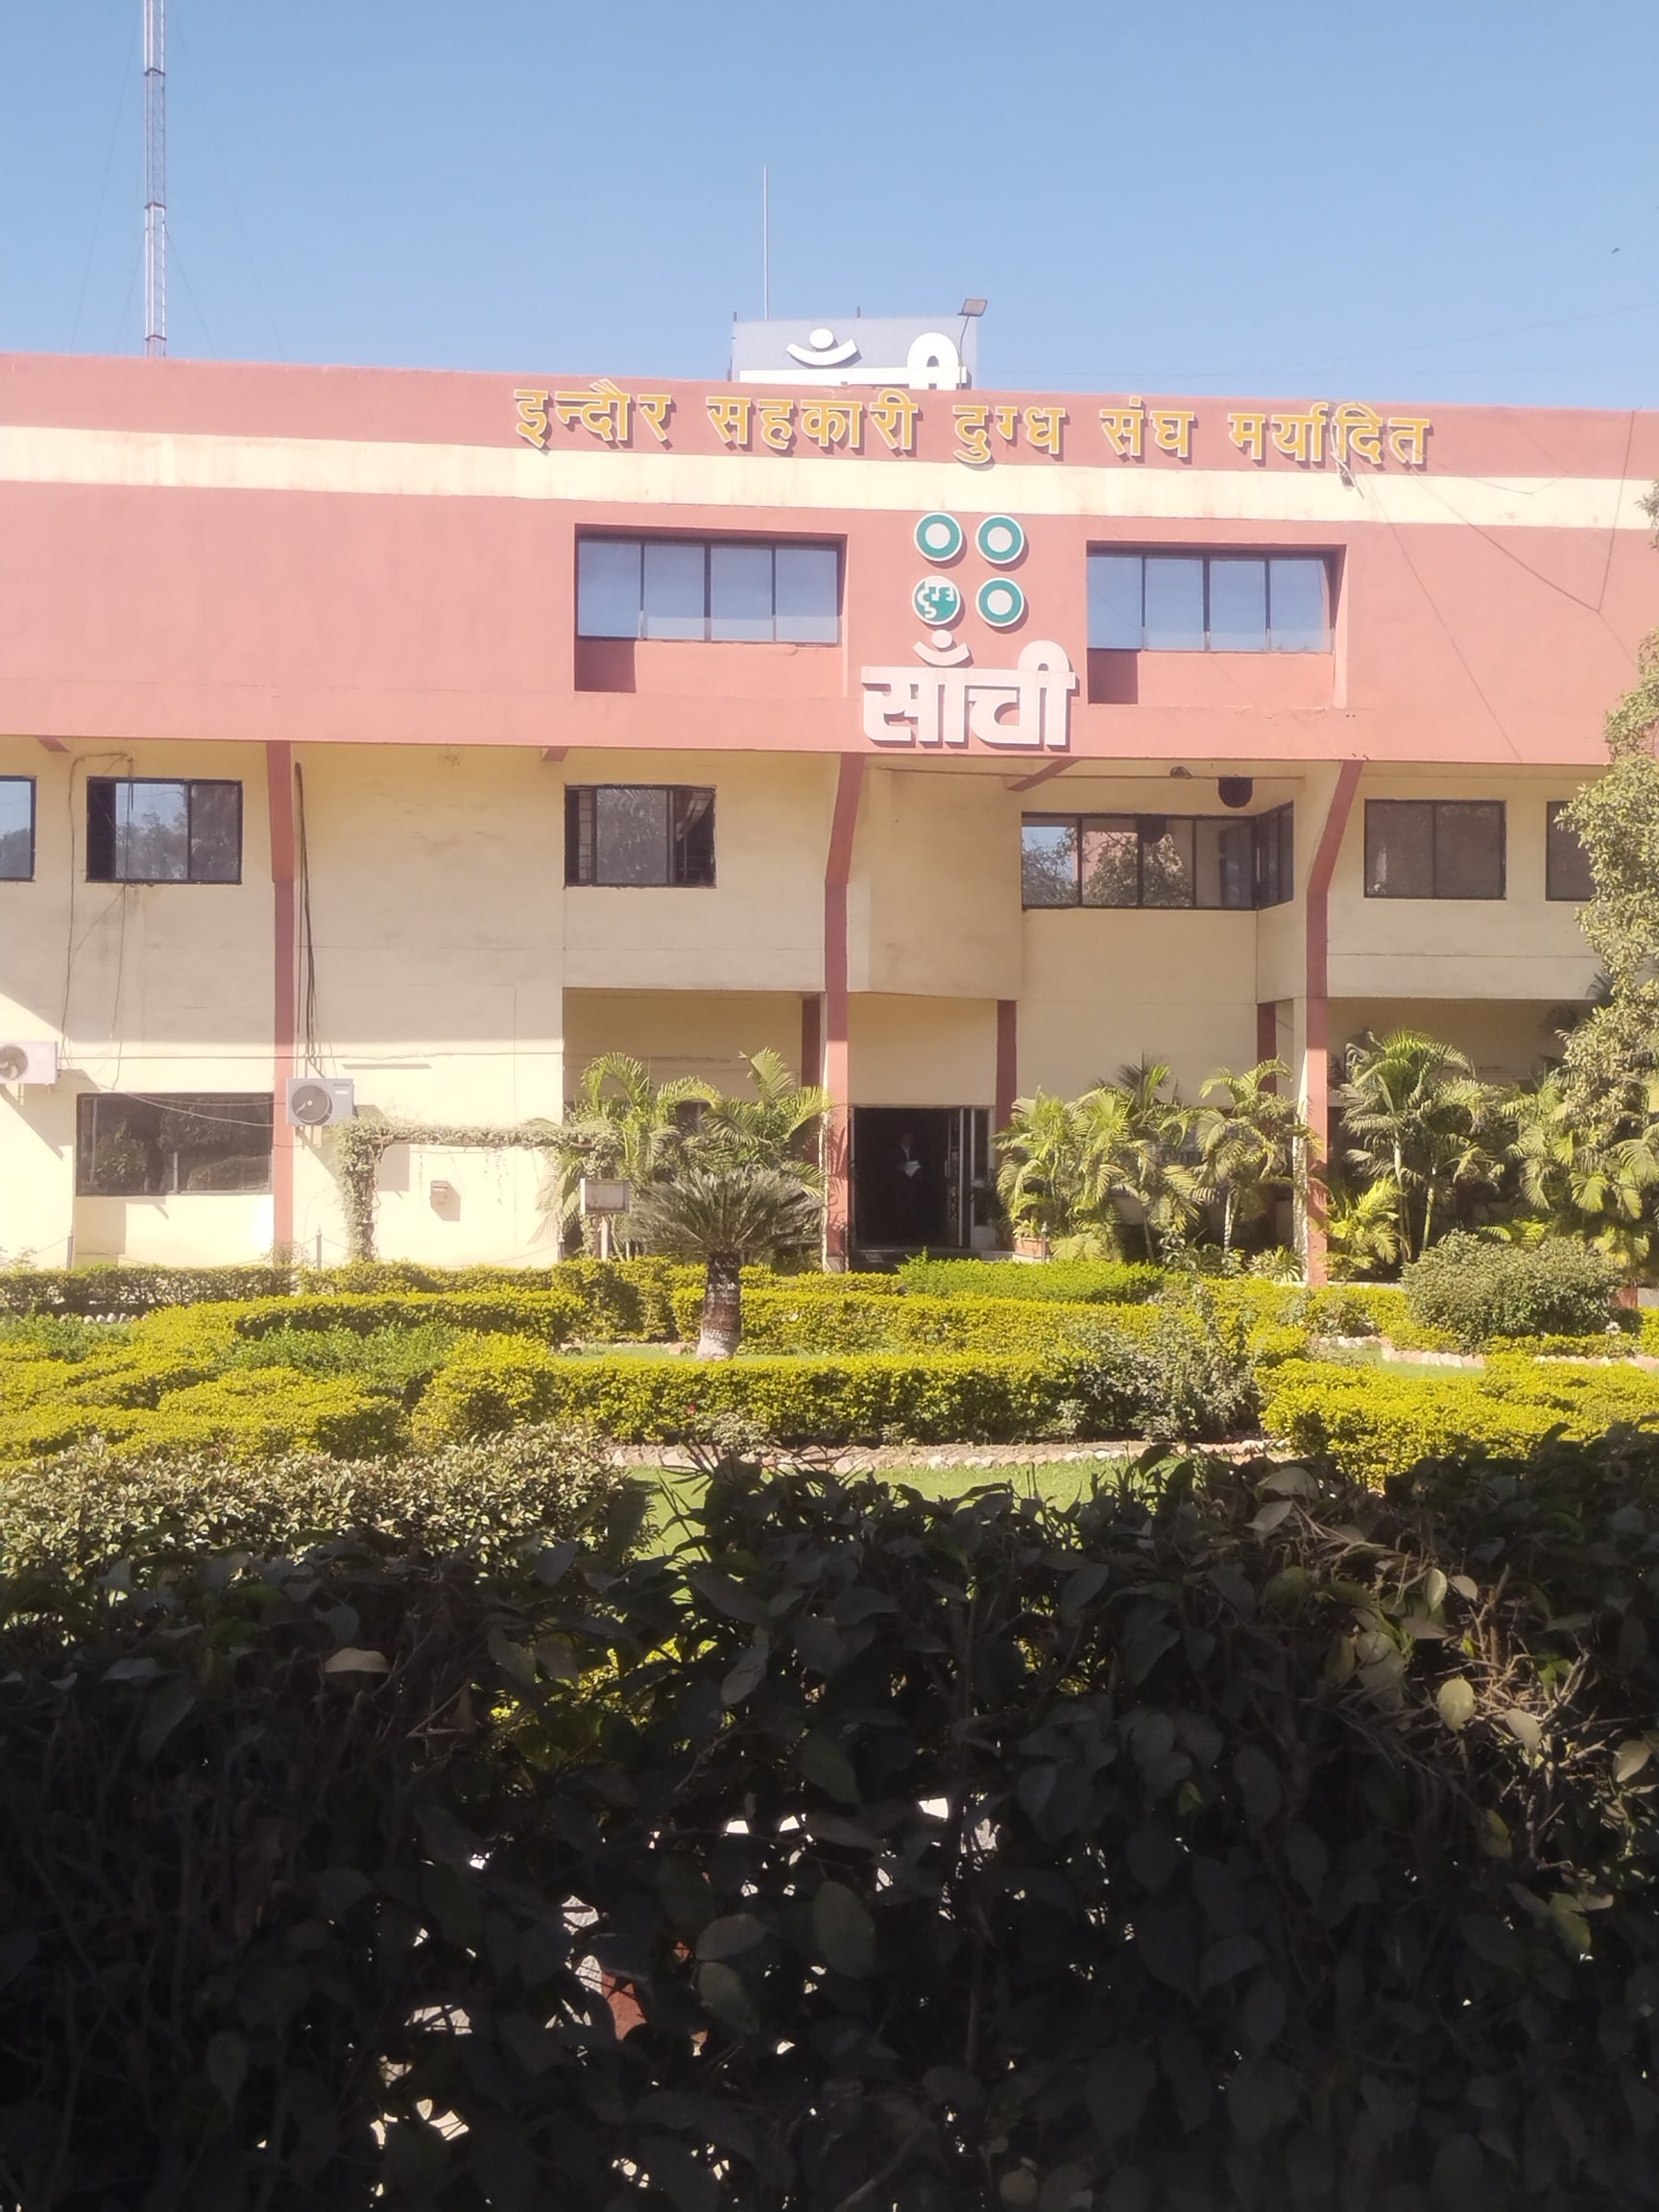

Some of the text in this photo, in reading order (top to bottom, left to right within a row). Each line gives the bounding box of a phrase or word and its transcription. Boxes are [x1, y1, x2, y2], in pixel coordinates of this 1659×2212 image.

[514, 378, 1431, 466] इन्दौर सहकारी दुग्ध संघ मर्यादित
